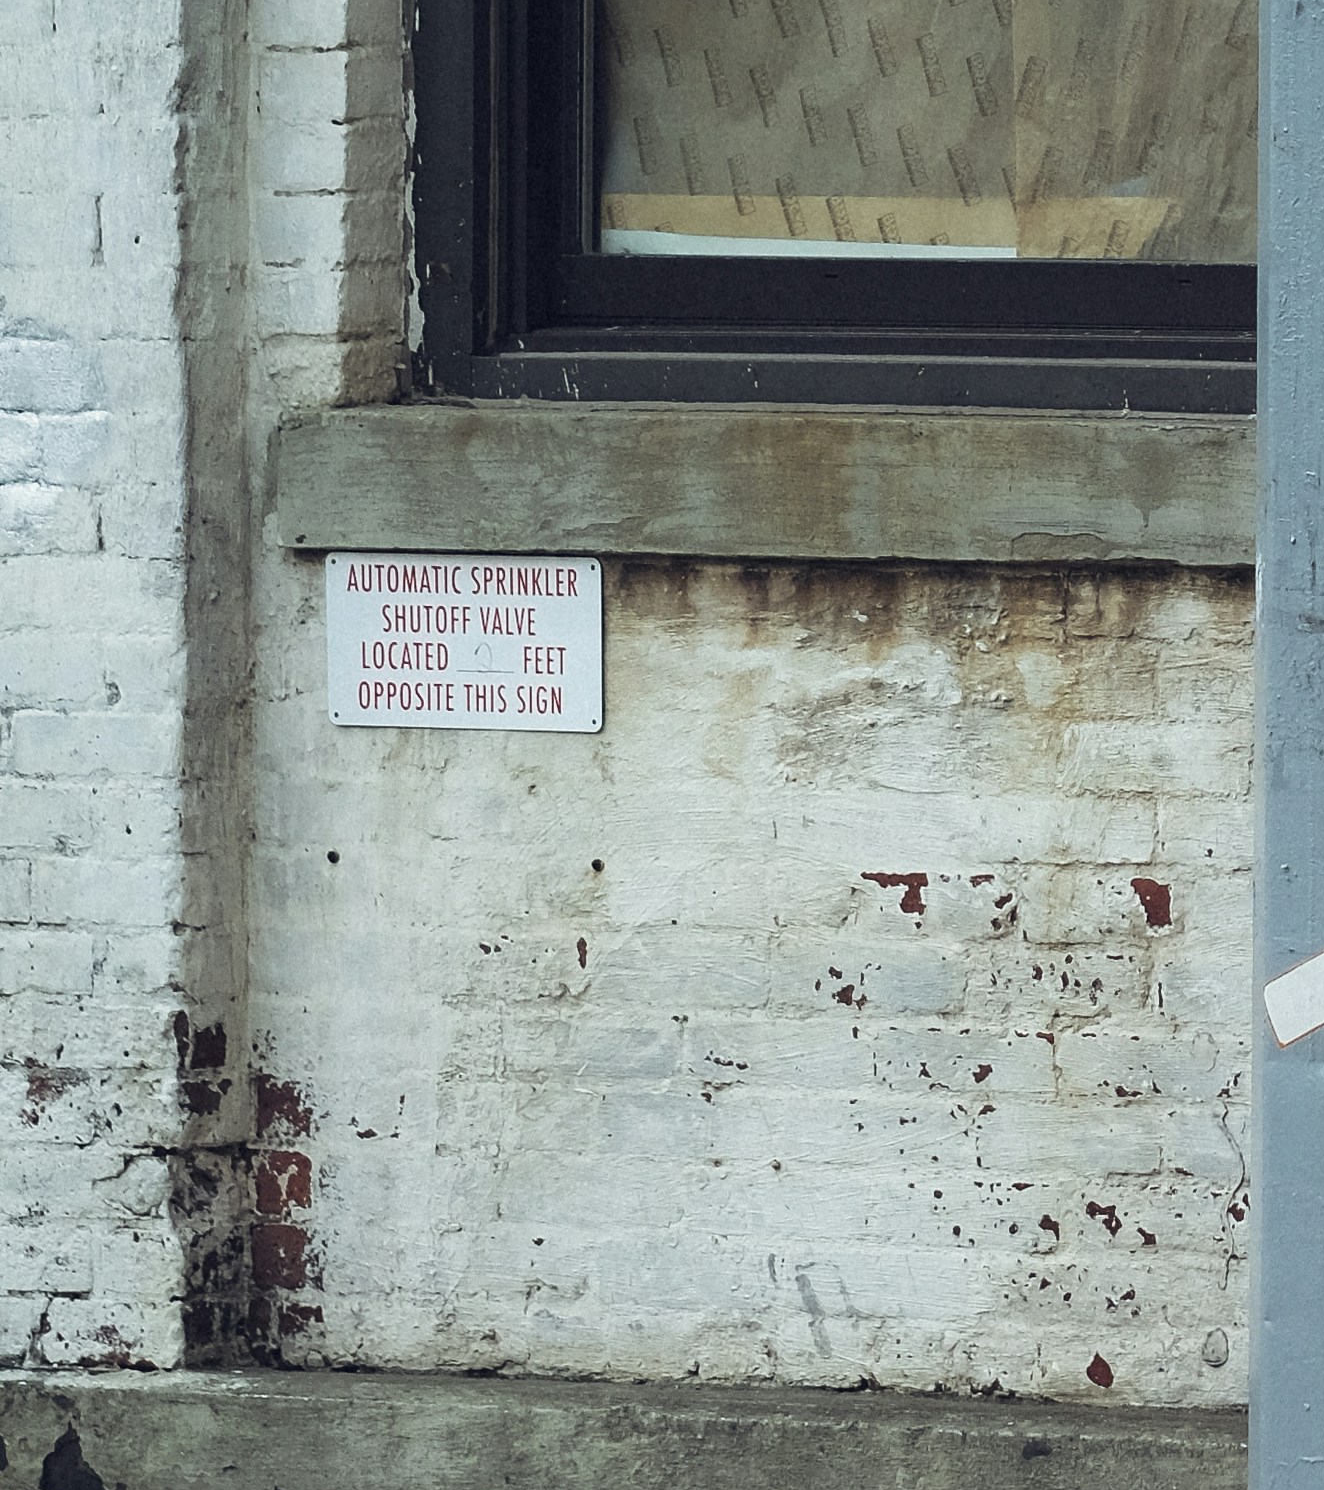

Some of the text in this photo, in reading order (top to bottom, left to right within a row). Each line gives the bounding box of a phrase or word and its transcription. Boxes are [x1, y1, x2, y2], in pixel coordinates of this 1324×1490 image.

[347, 564, 578, 597] AUTOMATIC SPRINKLER
[382, 604, 536, 636] SHUTOFF VALVE
[361, 641, 448, 671] LOCATED
[523, 647, 566, 675] FEET
[358, 681, 562, 715] OPPOSITE THIS SIGN
